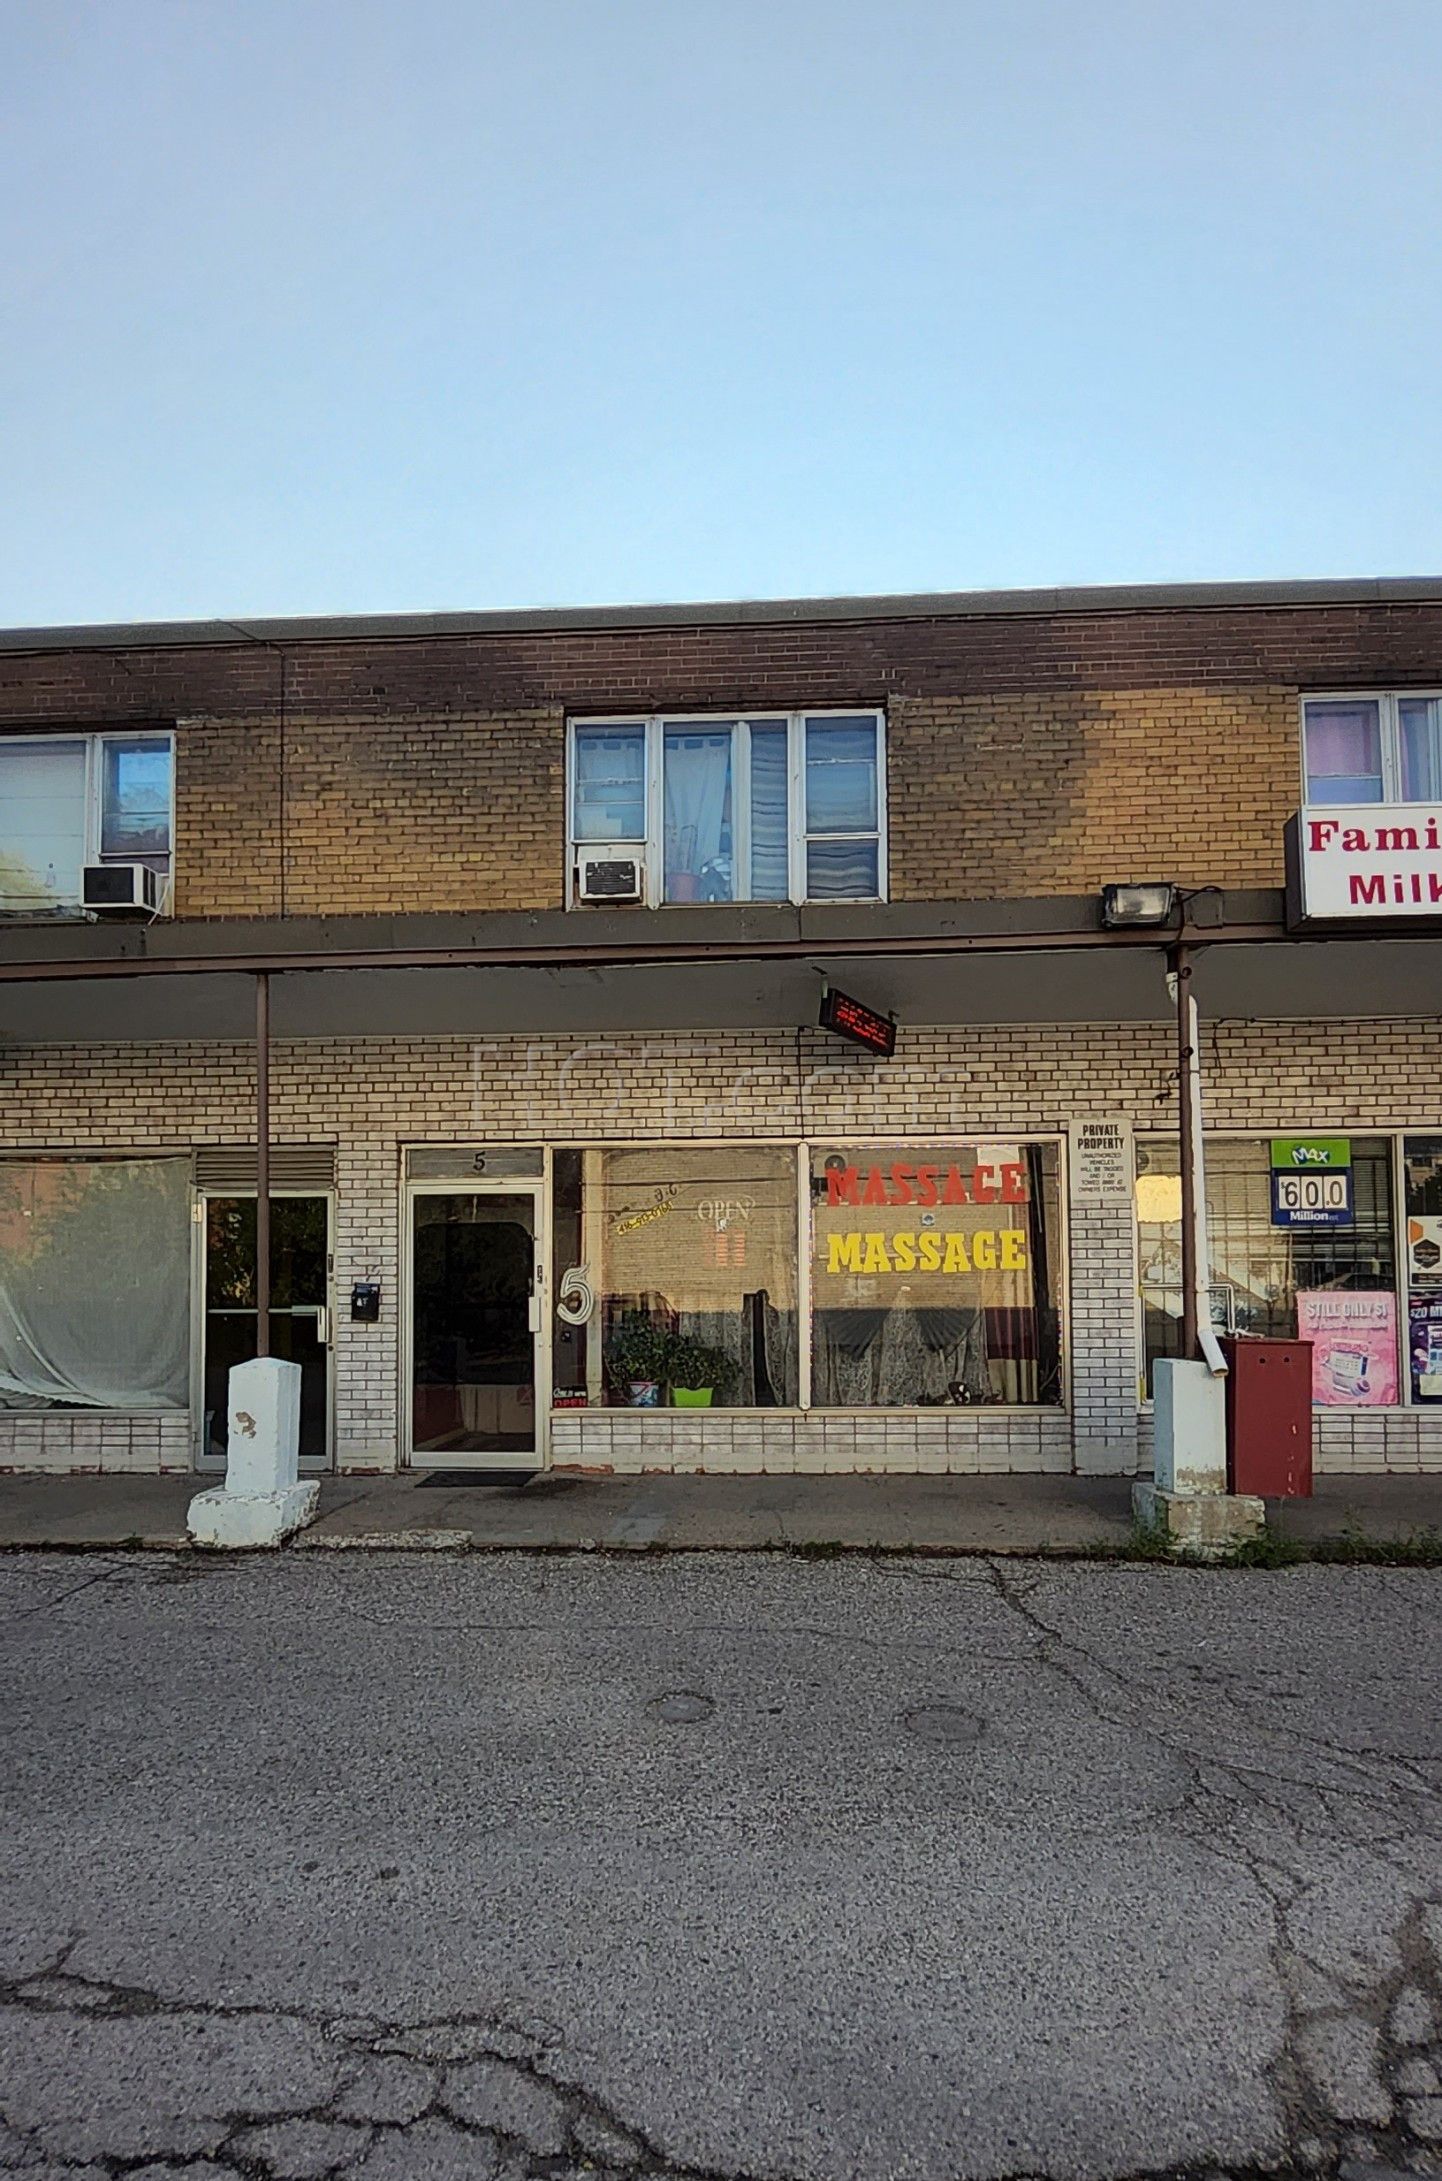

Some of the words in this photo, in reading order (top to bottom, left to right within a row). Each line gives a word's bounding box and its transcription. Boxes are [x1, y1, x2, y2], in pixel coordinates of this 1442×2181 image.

[1307, 817, 1441, 852] Fami
[1082, 1124, 1119, 1136] PRIVATE
[1077, 1137, 1125, 1150] PROPERTY
[473, 1150, 486, 1171] 5
[825, 1162, 1027, 1207] MASSAGE
[1290, 1211, 1329, 1221] Million
[827, 1230, 1026, 1274] MASSAGE
[557, 1263, 594, 1326] 5
[1306, 1302, 1341, 1319] STILL
